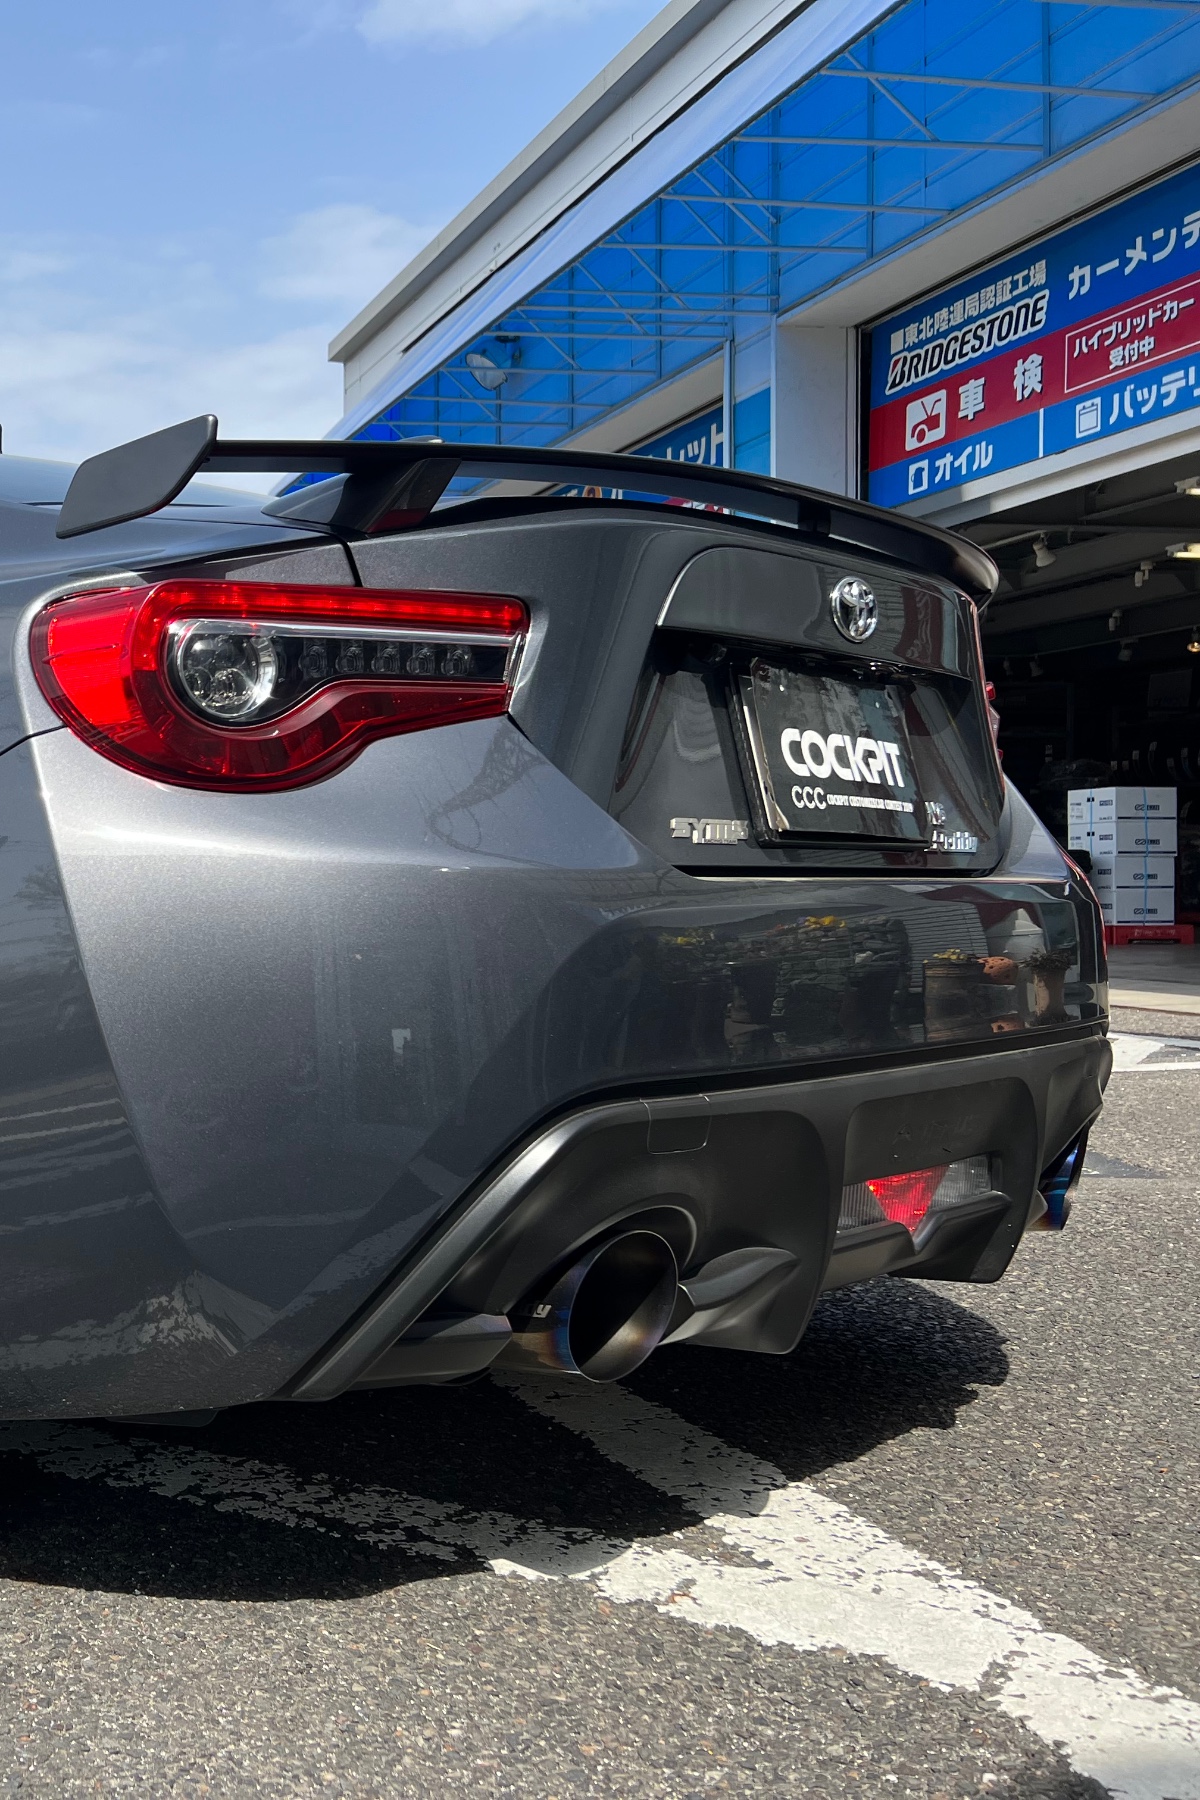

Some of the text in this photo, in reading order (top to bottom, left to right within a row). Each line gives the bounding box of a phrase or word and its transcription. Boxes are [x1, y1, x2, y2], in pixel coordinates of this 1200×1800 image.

[887, 290, 1048, 394] BRIDGESTONE
[1073, 298, 1195, 358] ハイブリッドカー
[1109, 335, 1155, 370] 受付中
[934, 441, 994, 484] オイル
[781, 728, 905, 787] COCKPIT
[791, 785, 827, 809] CCC
